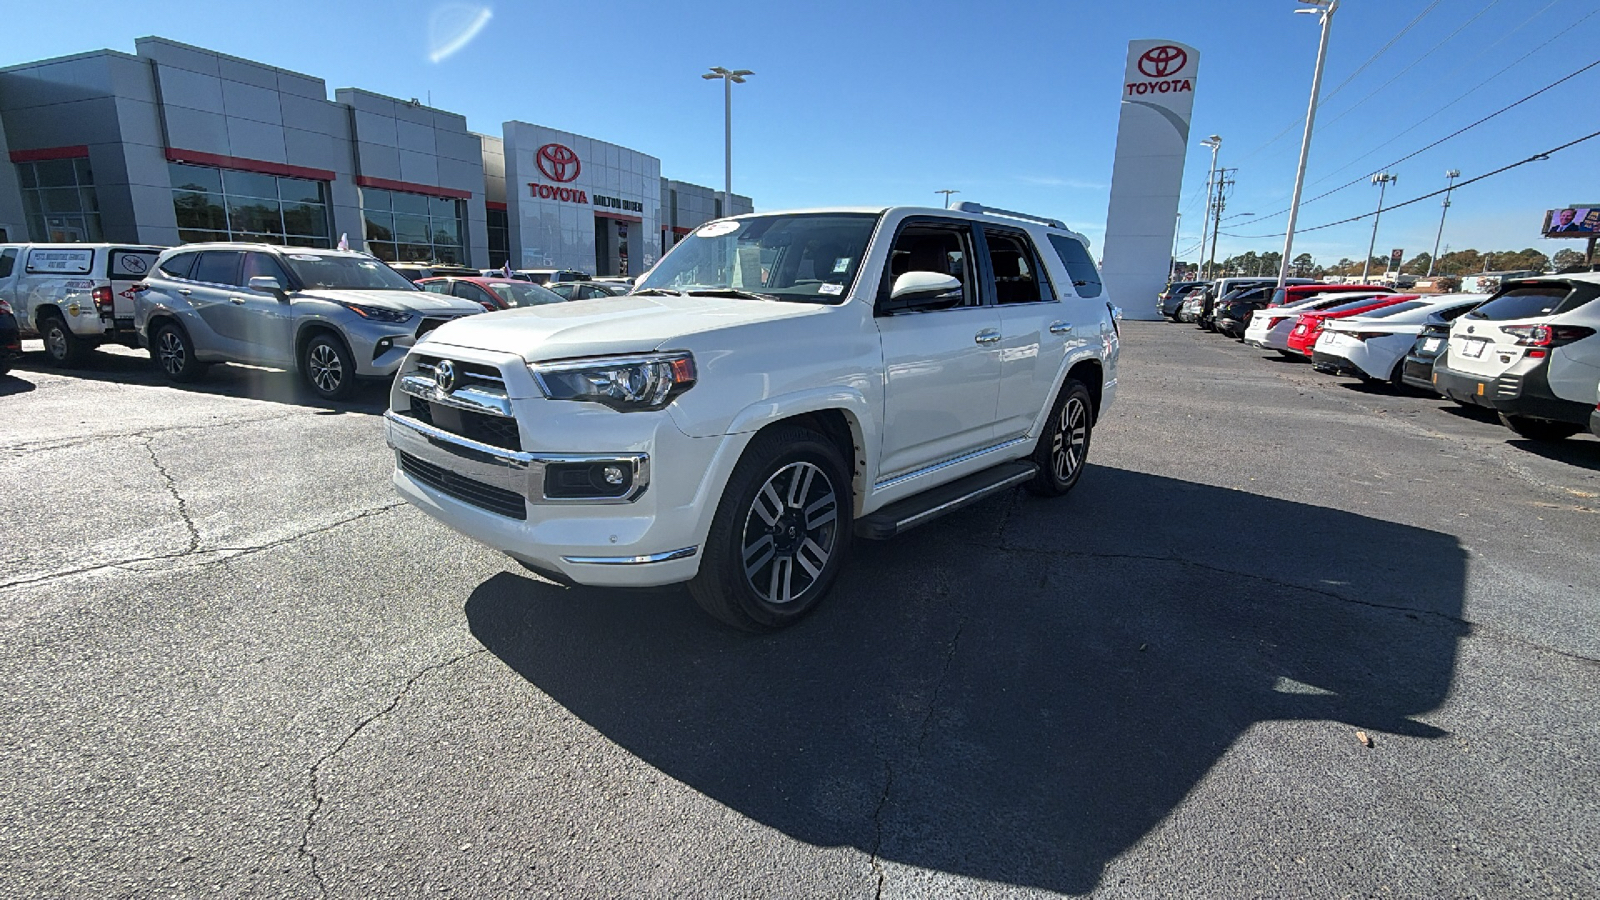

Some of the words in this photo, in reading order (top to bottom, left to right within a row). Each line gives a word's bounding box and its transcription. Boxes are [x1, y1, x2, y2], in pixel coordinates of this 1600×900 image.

[1127, 80, 1191, 95] TOYOTA
[528, 183, 588, 204] TOYOTA
[593, 195, 621, 209] MILTON
